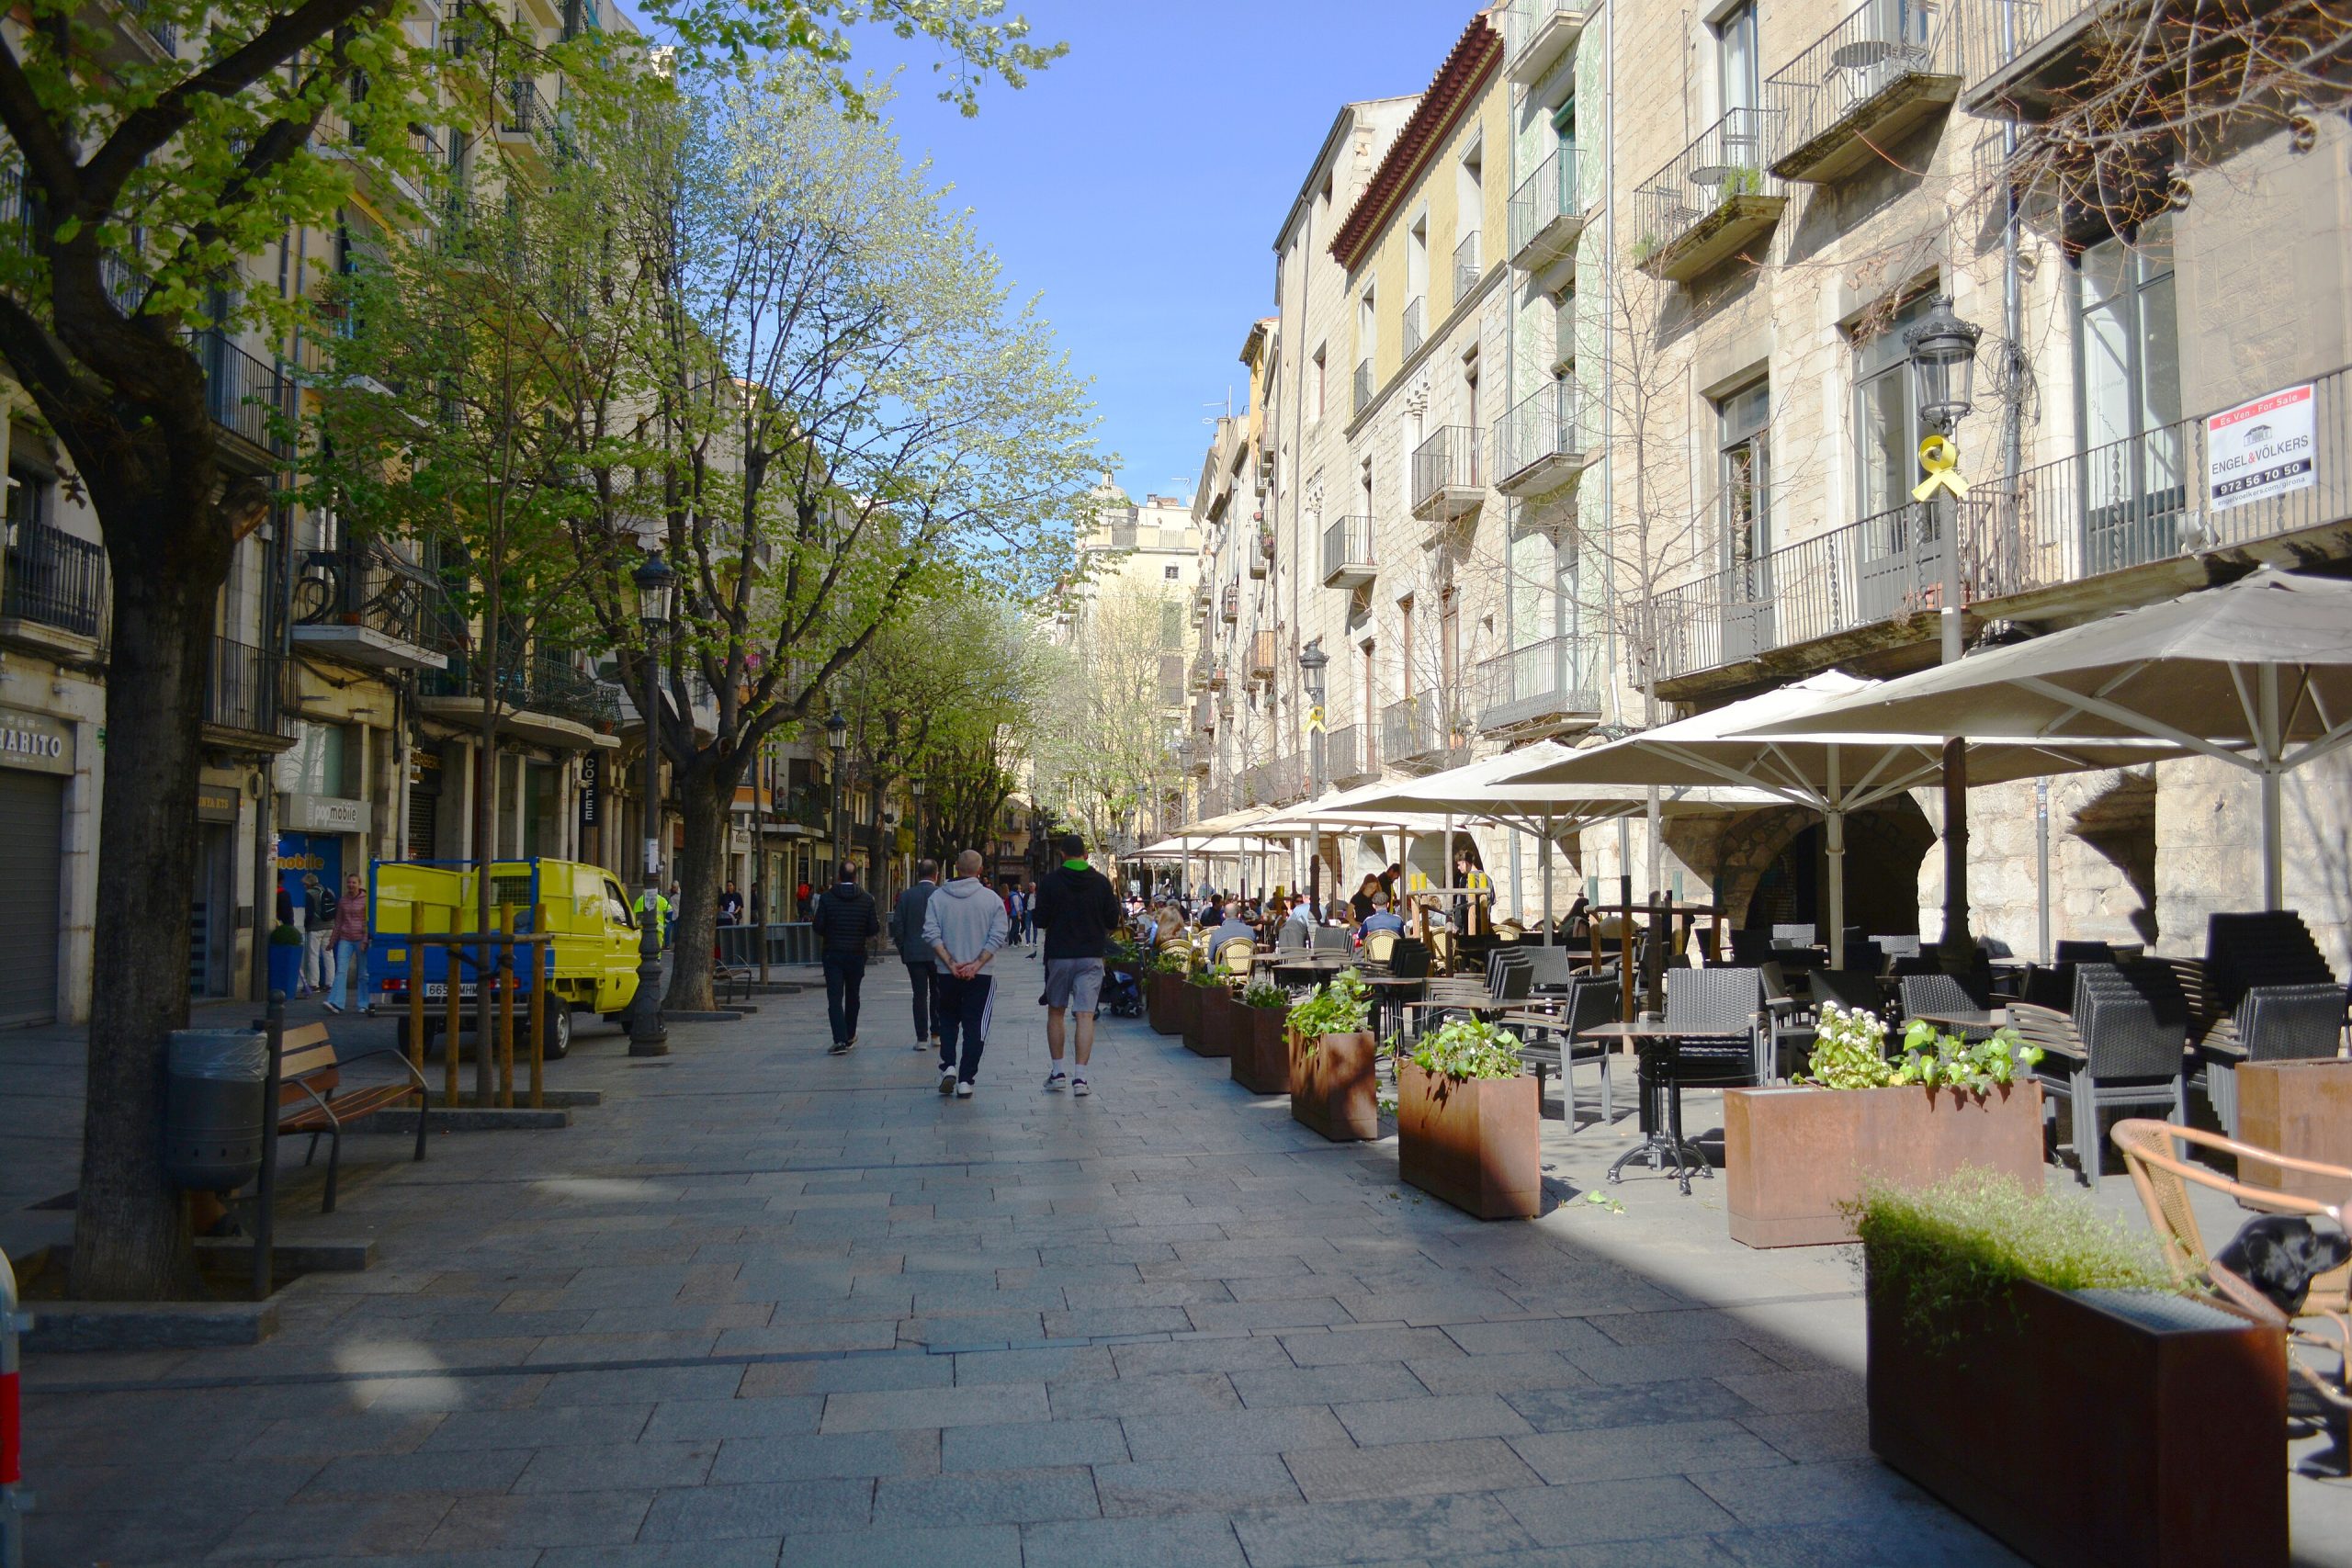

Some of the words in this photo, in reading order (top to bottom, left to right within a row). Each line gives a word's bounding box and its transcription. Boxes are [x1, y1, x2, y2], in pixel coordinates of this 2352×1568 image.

[2220, 417, 2231, 426] Es
[2233, 412, 2250, 421] Ven
[2257, 402, 2273, 412] For
[2277, 395, 2298, 405] Sale
[2220, 480, 2242, 494] 972
[2245, 475, 2260, 487] 56
[2264, 469, 2279, 481] 70
[2283, 463, 2300, 475] 50
[584, 758, 595, 820] COFFEE
[314, 801, 357, 827] popmobile
